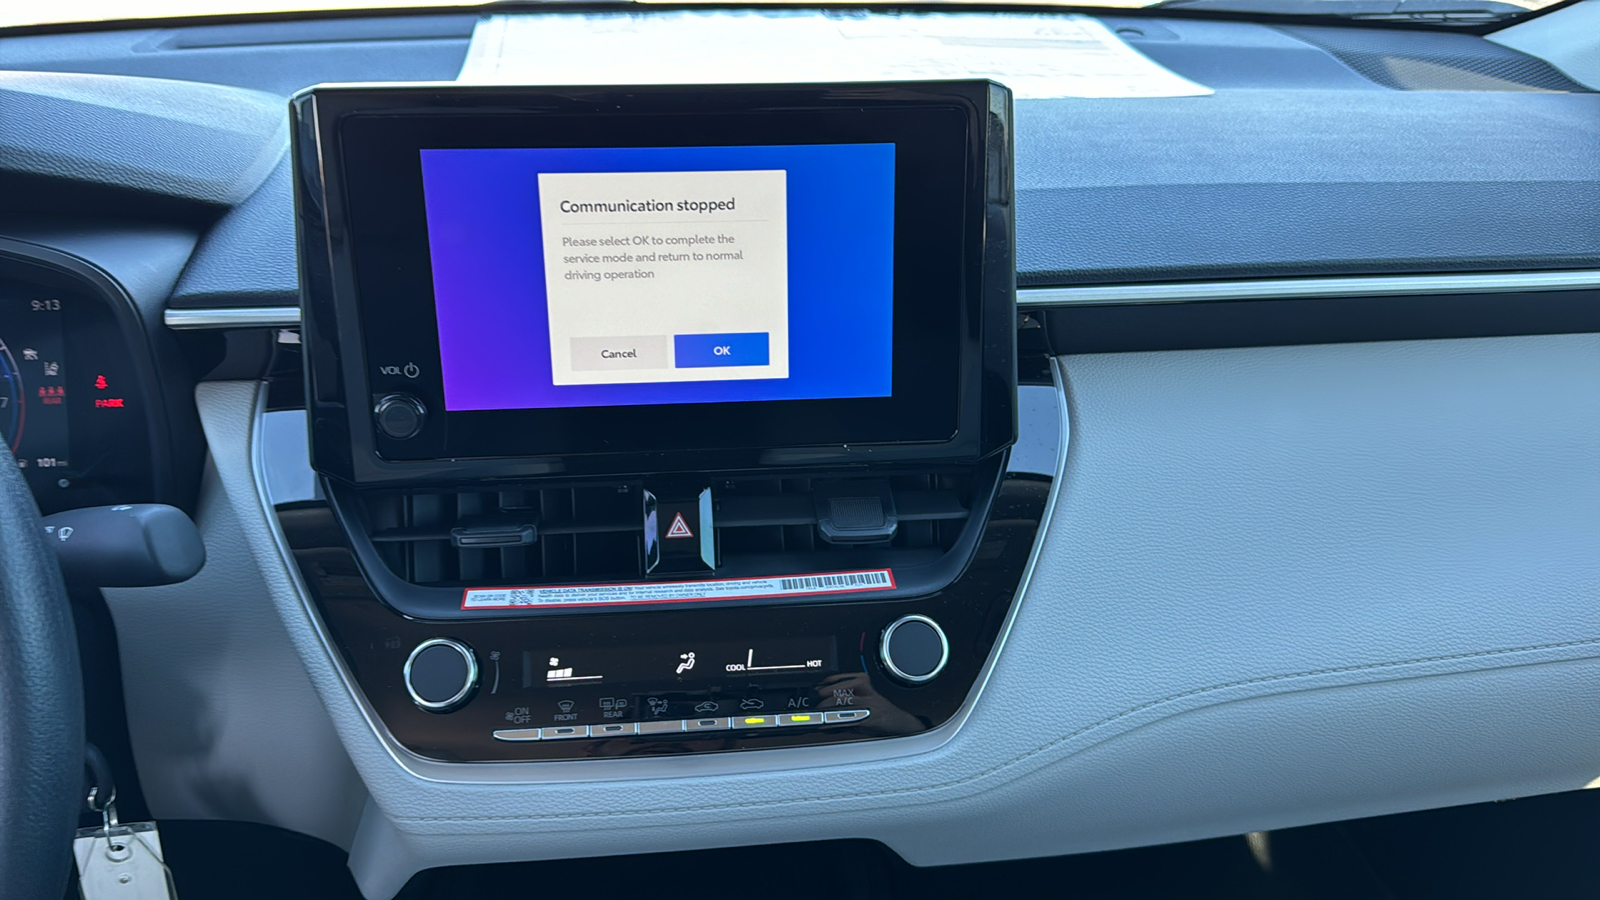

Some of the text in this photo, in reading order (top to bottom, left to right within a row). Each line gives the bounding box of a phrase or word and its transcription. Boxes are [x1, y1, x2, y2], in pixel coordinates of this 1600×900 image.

[560, 198, 736, 214] Communication stopped
[562, 234, 735, 247] Please select OK to complete the
[563, 250, 743, 263] service mode and return to normal
[564, 269, 654, 281] driving operation
[31, 299, 61, 312] 9:13
[601, 348, 637, 359] Cancel
[713, 346, 731, 356] OK
[380, 366, 402, 375] VOL
[95, 398, 124, 408] PARK
[37, 458, 56, 468] 101
[725, 664, 745, 672] COOL
[806, 660, 822, 668] HOT
[833, 689, 854, 697] MAX
[788, 697, 810, 708] A/C
[836, 697, 854, 706] A/C
[515, 707, 530, 716] ON
[554, 712, 578, 721] FRONT
[604, 710, 623, 718] REAR
[514, 715, 532, 724] OFF
